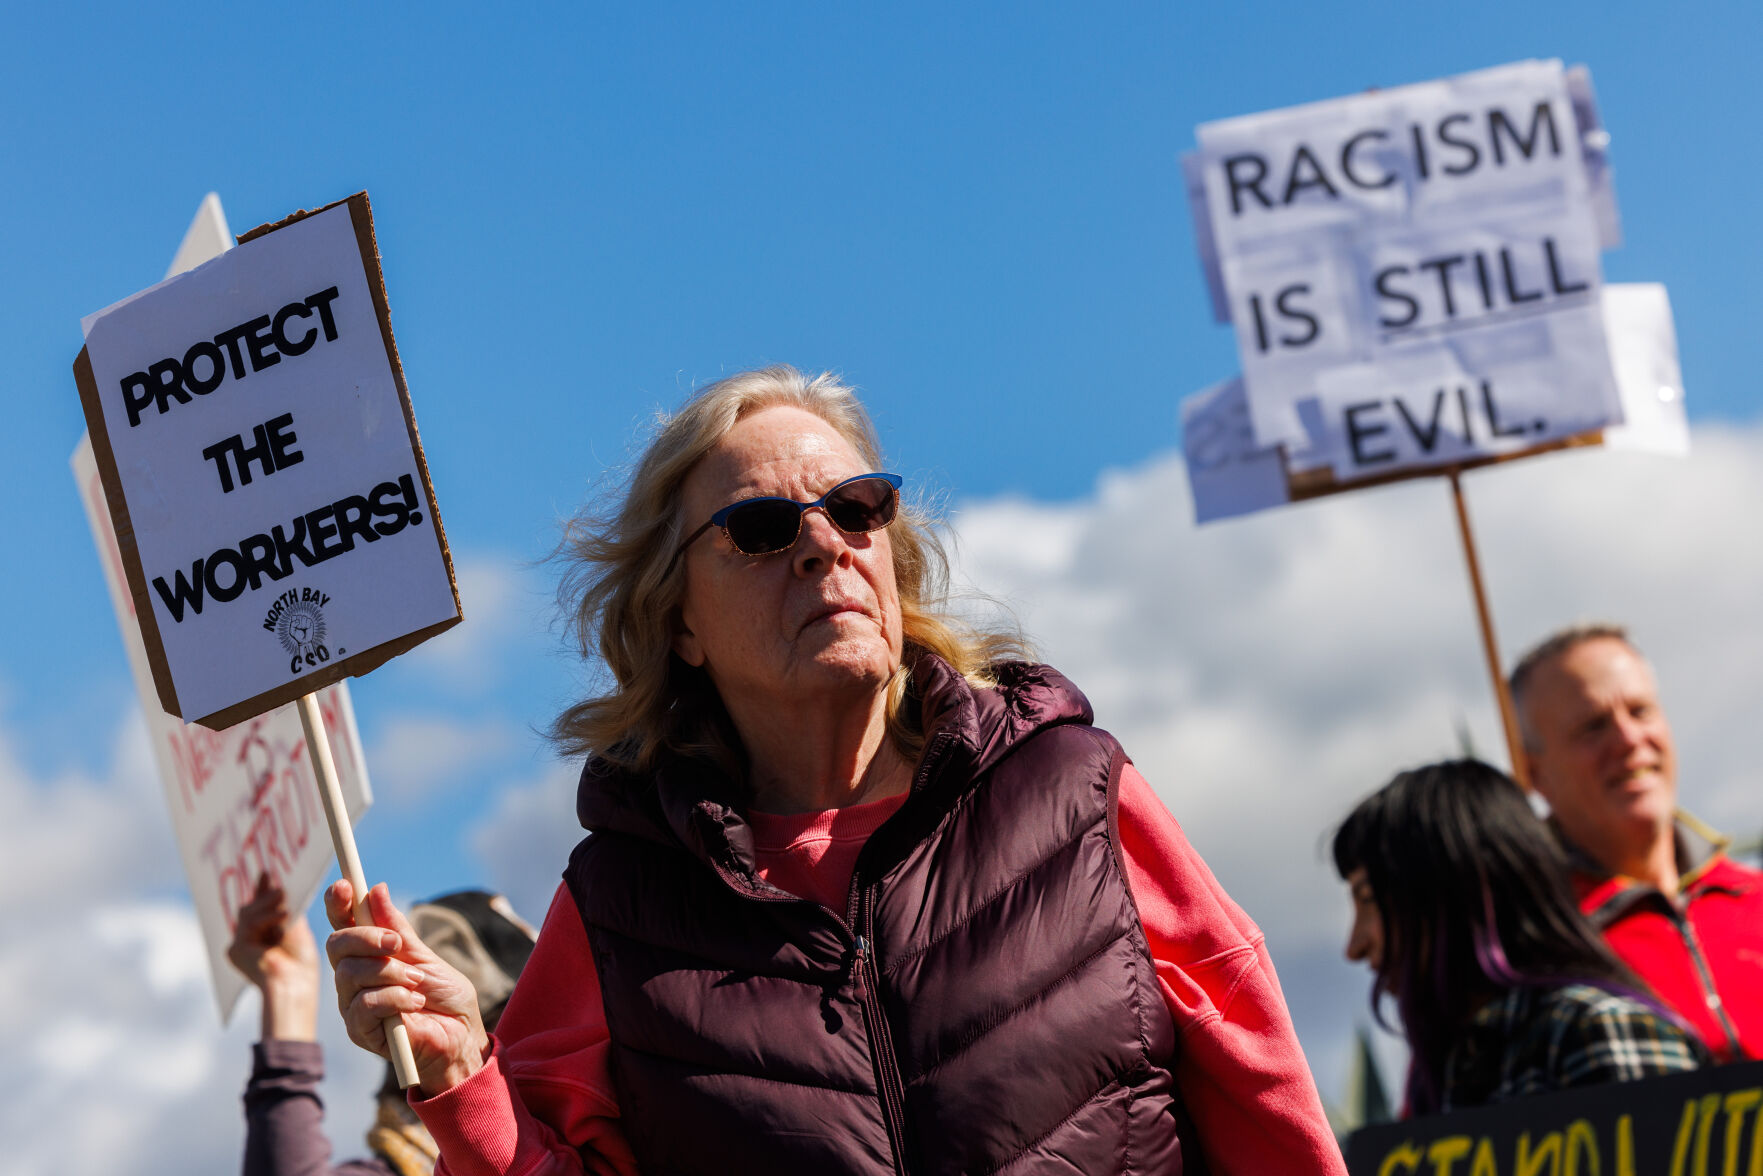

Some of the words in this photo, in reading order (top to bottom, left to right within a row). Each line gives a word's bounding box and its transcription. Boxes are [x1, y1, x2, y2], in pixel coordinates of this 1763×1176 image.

[1222, 101, 1563, 215] RACISM
[1248, 284, 1322, 353] IS
[1372, 237, 1590, 330] STILL
[119, 285, 340, 428] PROTECT
[202, 412, 305, 494] THE
[1341, 380, 1548, 468] EVIL.
[151, 473, 424, 624] WORKERS!
[262, 587, 299, 633] NORTH
[301, 586, 331, 609] BAY
